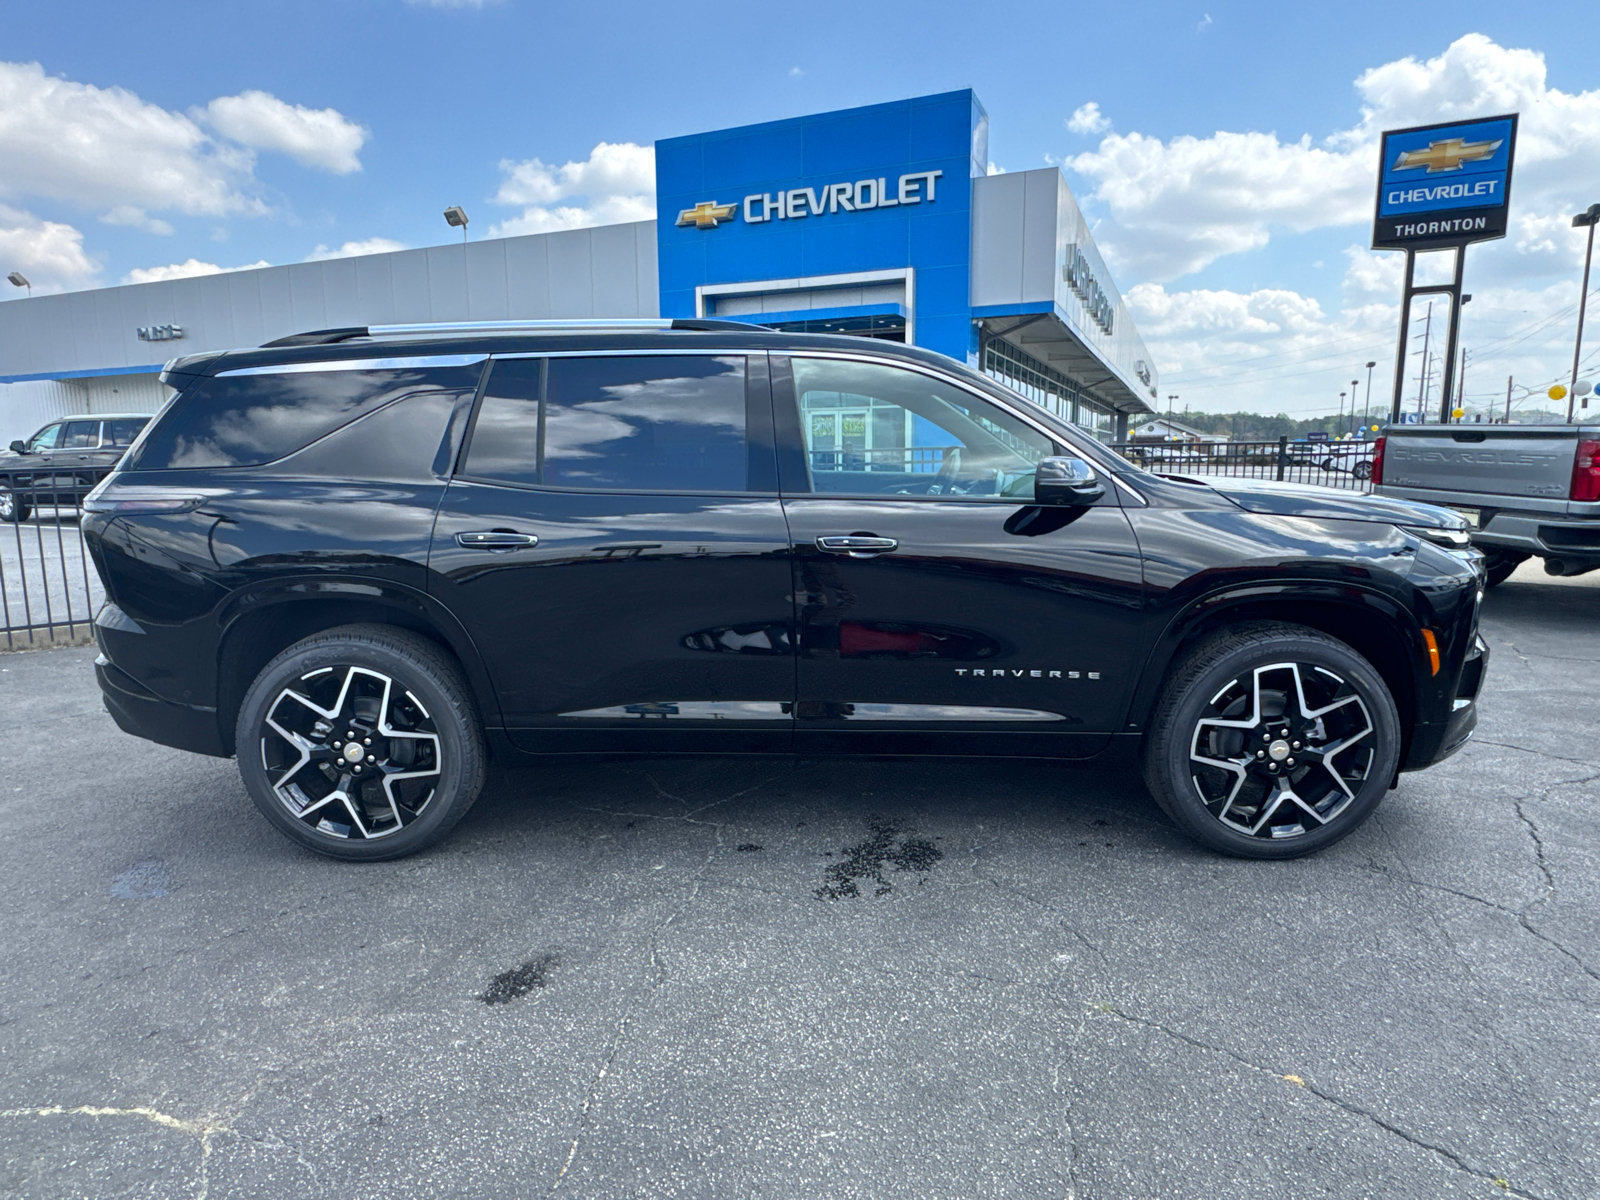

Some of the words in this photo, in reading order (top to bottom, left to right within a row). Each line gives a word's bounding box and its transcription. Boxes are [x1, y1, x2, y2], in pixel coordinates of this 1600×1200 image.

[744, 170, 943, 223] CHEVROLET
[1388, 180, 1498, 205] CHEVROLET
[1395, 217, 1486, 237] THORNTON
[137, 324, 182, 341] PARTS
[1393, 449, 1559, 467] CHEVROLET
[955, 669, 1100, 680] TRAVERSE
